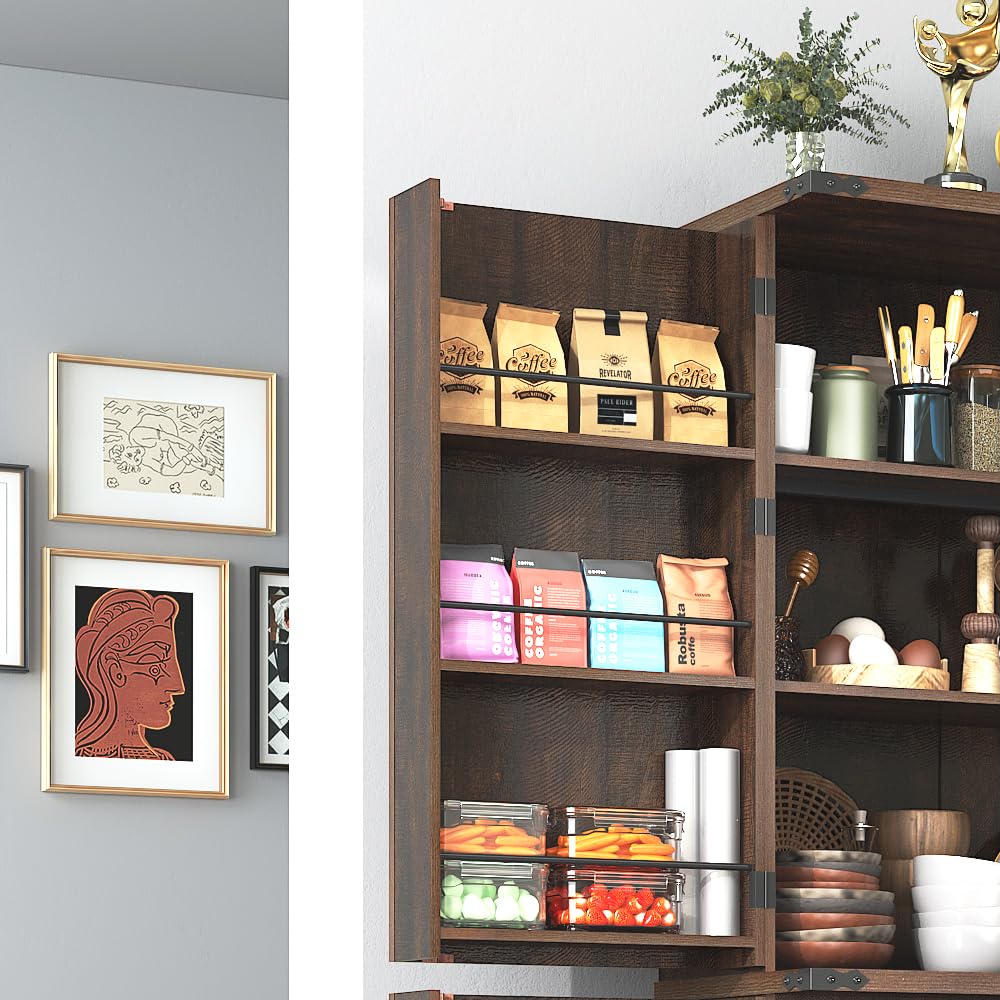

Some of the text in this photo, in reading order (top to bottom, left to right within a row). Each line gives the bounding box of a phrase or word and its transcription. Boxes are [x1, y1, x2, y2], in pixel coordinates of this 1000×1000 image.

[599, 368, 632, 380] REVELATOR
[667, 367, 717, 388] Coffee
[524, 598, 534, 659] COFFE
[688, 636, 696, 666] coffe
